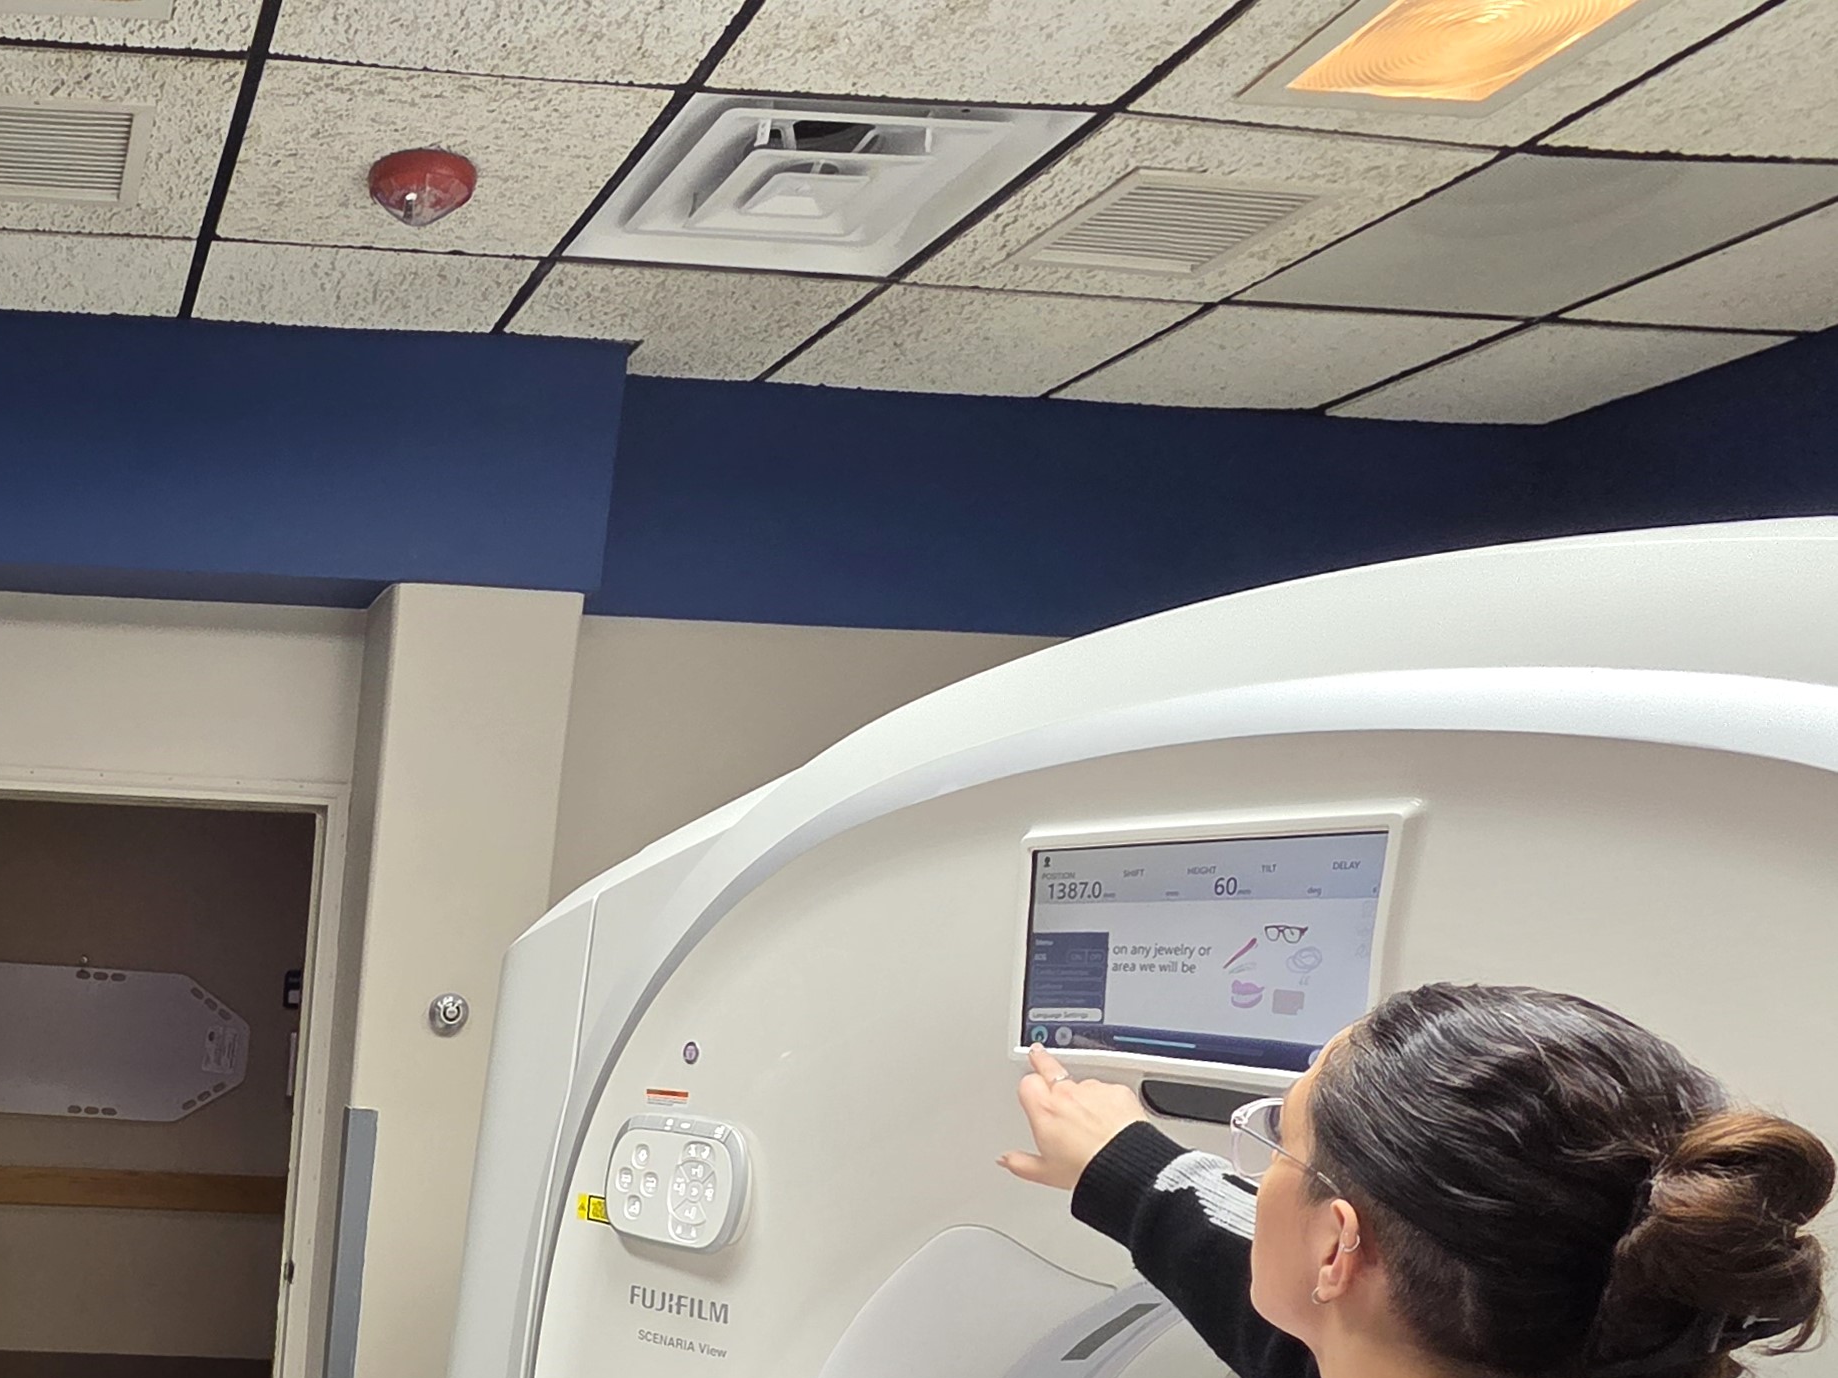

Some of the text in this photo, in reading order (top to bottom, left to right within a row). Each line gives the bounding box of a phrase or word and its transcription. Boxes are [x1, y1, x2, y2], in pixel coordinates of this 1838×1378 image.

[1262, 863, 1277, 873] TILT
[1332, 860, 1362, 870] DELAY
[1048, 881, 1103, 900] 1387.0
[1214, 876, 1238, 896] 60
[1112, 942, 1213, 959] on any jewelry or
[1111, 960, 1198, 974] area we will be
[629, 1284, 729, 1325] FUJIFILM
[637, 1328, 728, 1359] SCENARIA View
